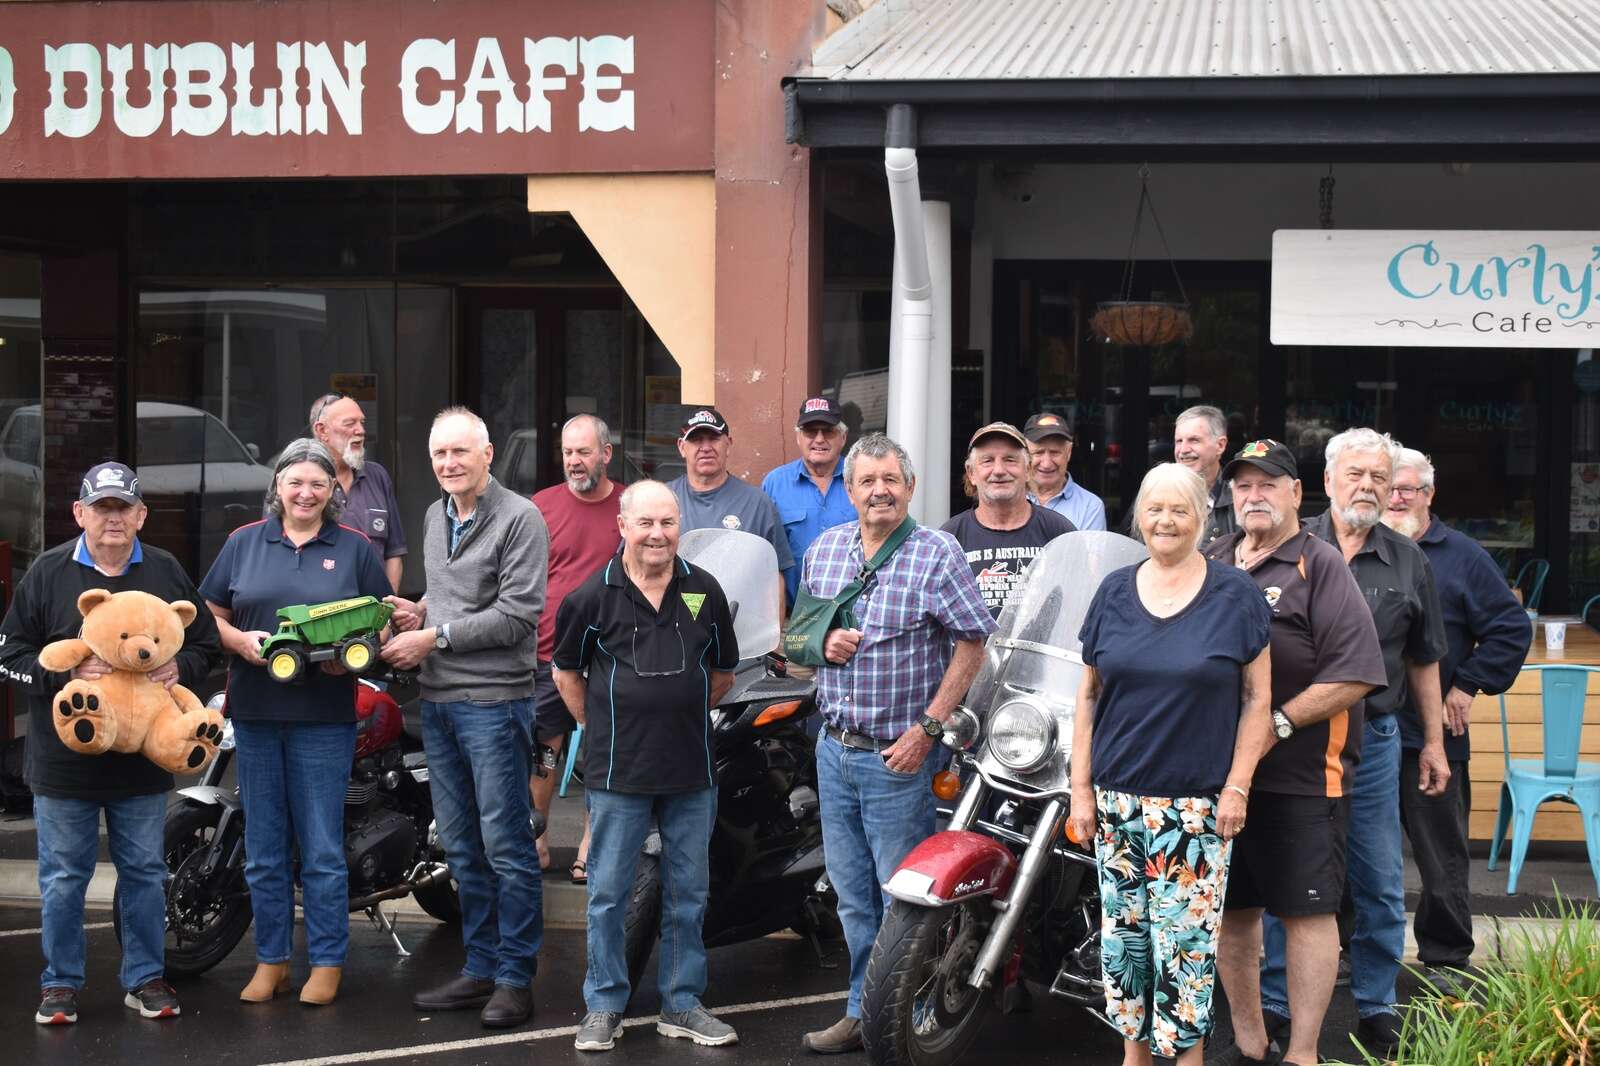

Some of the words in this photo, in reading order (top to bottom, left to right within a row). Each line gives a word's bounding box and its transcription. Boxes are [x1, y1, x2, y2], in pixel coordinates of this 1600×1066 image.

[44, 40, 366, 138] DUBLIN
[398, 35, 635, 134] CAFE
[1387, 240, 1600, 320] Curly'
[1472, 312, 1552, 332] Cafe
[983, 548, 993, 560] IS
